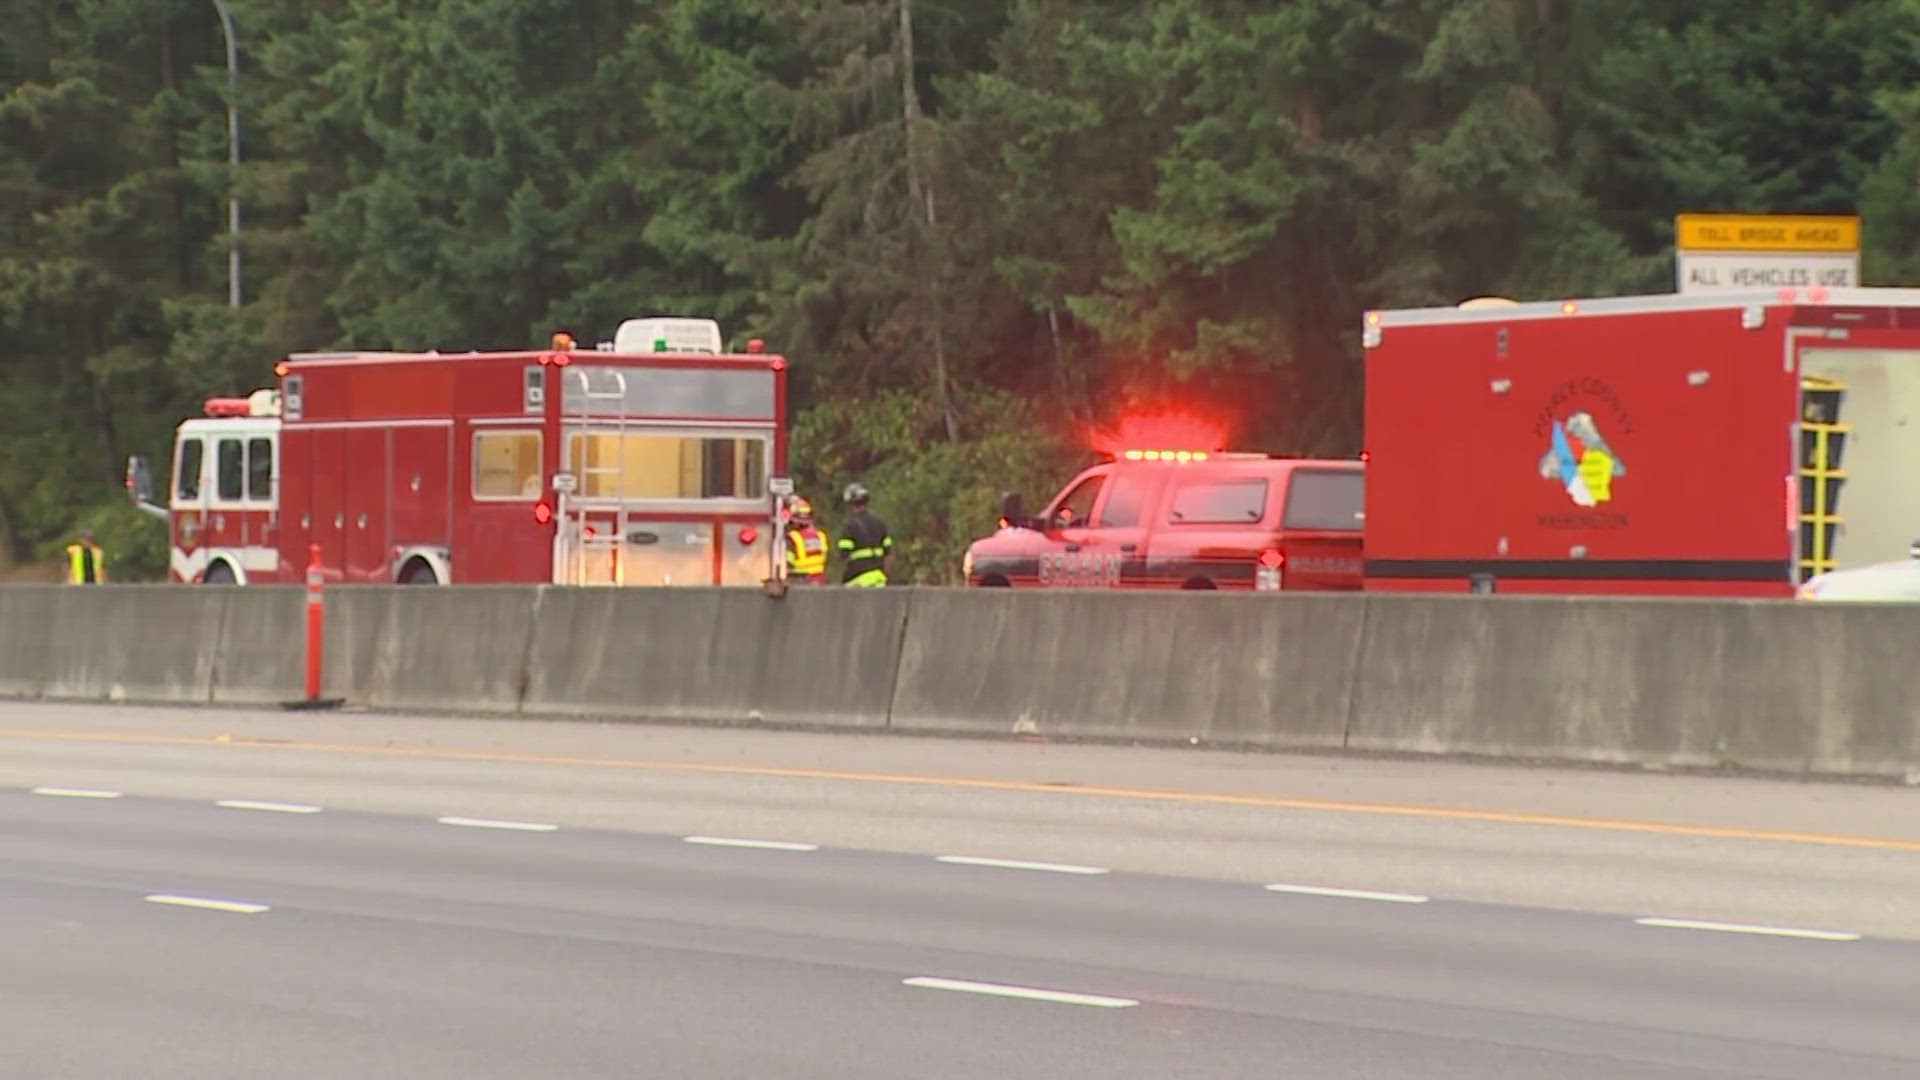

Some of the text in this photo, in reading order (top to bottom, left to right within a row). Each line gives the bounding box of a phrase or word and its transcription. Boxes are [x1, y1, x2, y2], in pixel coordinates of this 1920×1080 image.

[1690, 268, 1849, 287] ALL VEHICLES USE
